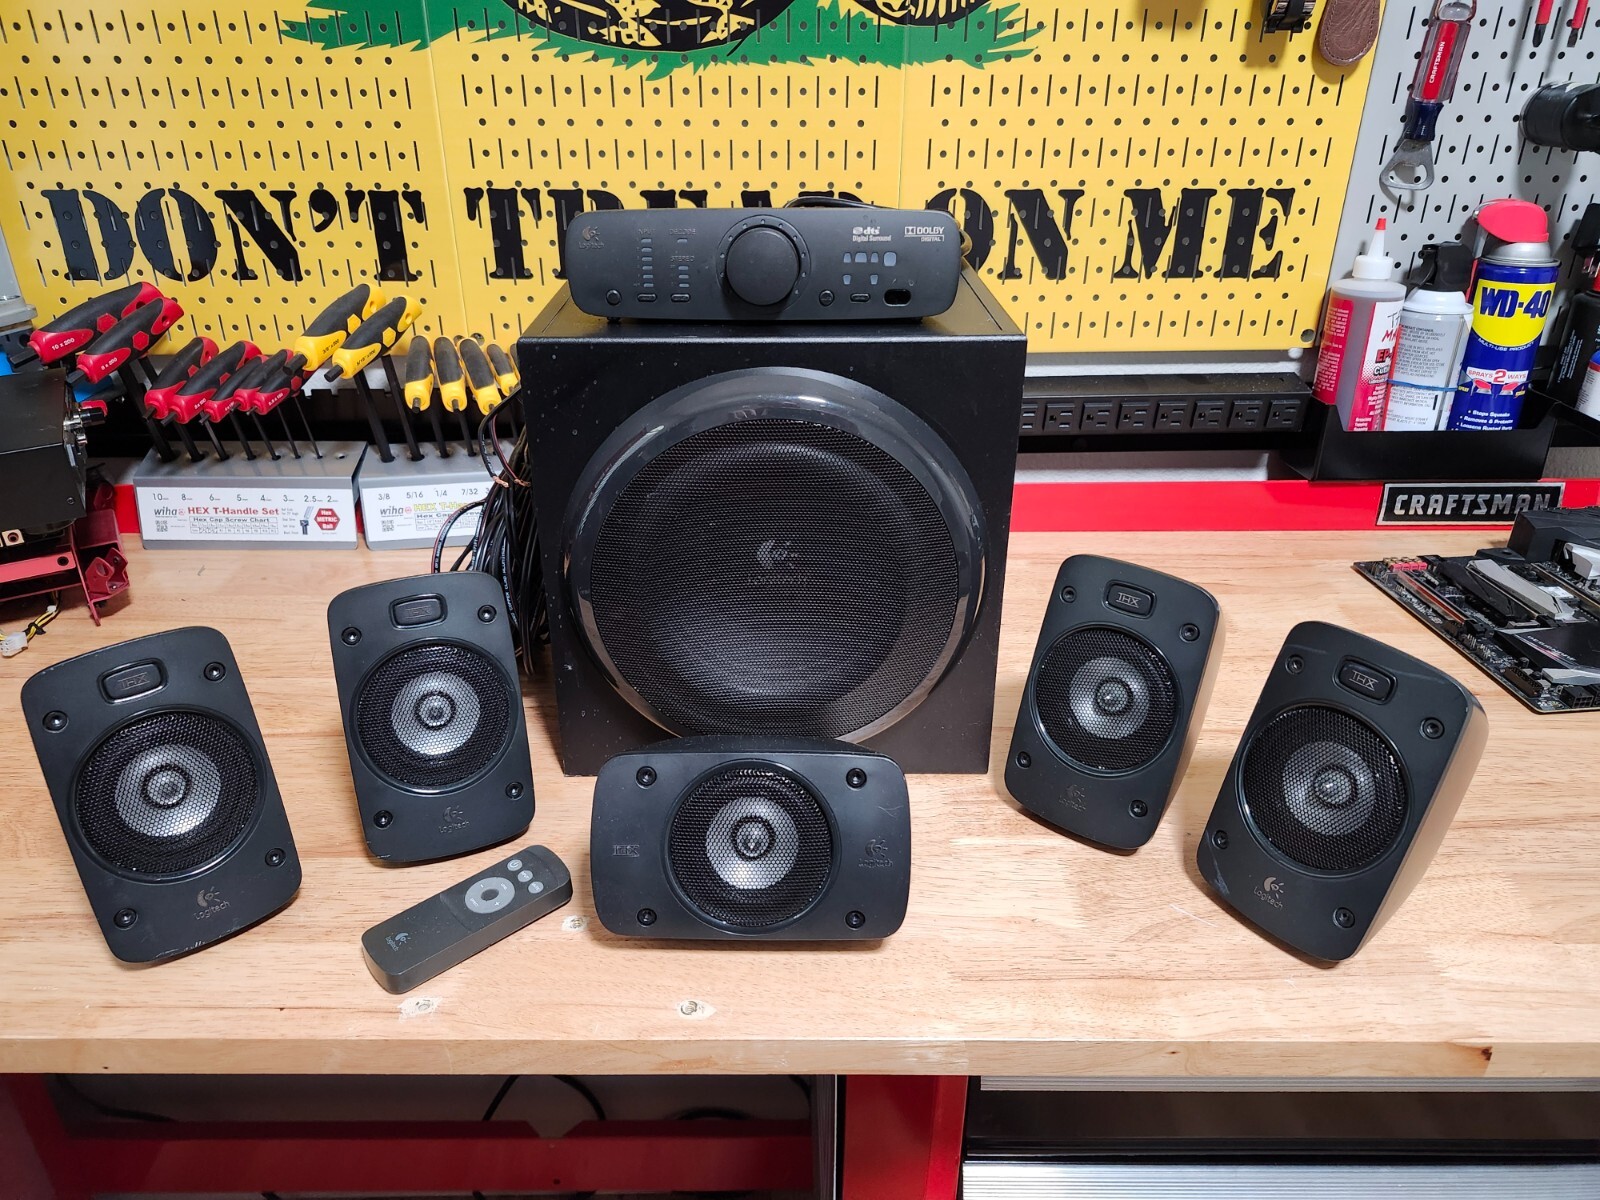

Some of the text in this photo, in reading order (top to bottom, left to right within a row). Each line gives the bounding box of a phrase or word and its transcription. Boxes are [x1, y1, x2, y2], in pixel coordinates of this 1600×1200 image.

[1429, 41, 1446, 84] CRAFTSMAN
[864, 226, 881, 235] dts
[917, 226, 945, 235] DOLBY
[925, 187, 1085, 280] ON
[1112, 187, 1296, 280] ME
[852, 235, 868, 243] Digital
[1480, 287, 1553, 319] WD-40
[1478, 338, 1535, 352] MULTI-USE PRODUCT
[1468, 370, 1493, 379] SPRAYS
[1493, 369, 1507, 383] 2
[378, 493, 391, 501] 3/8
[406, 491, 424, 499] 5/16
[435, 489, 448, 498] 1/4
[461, 488, 479, 496] 7/32
[154, 506, 178, 516] wiha
[187, 507, 280, 516] HEX T-Handle Set
[380, 505, 404, 516] wiha
[1393, 494, 1551, 515] CRAFTSMAN
[209, 516, 224, 524] Cap
[1115, 592, 1142, 609] THX
[1349, 669, 1379, 692] THX
[1253, 886, 1284, 909] Logitech
[193, 900, 231, 920] Logitech
[385, 935, 400, 951] Logitech
